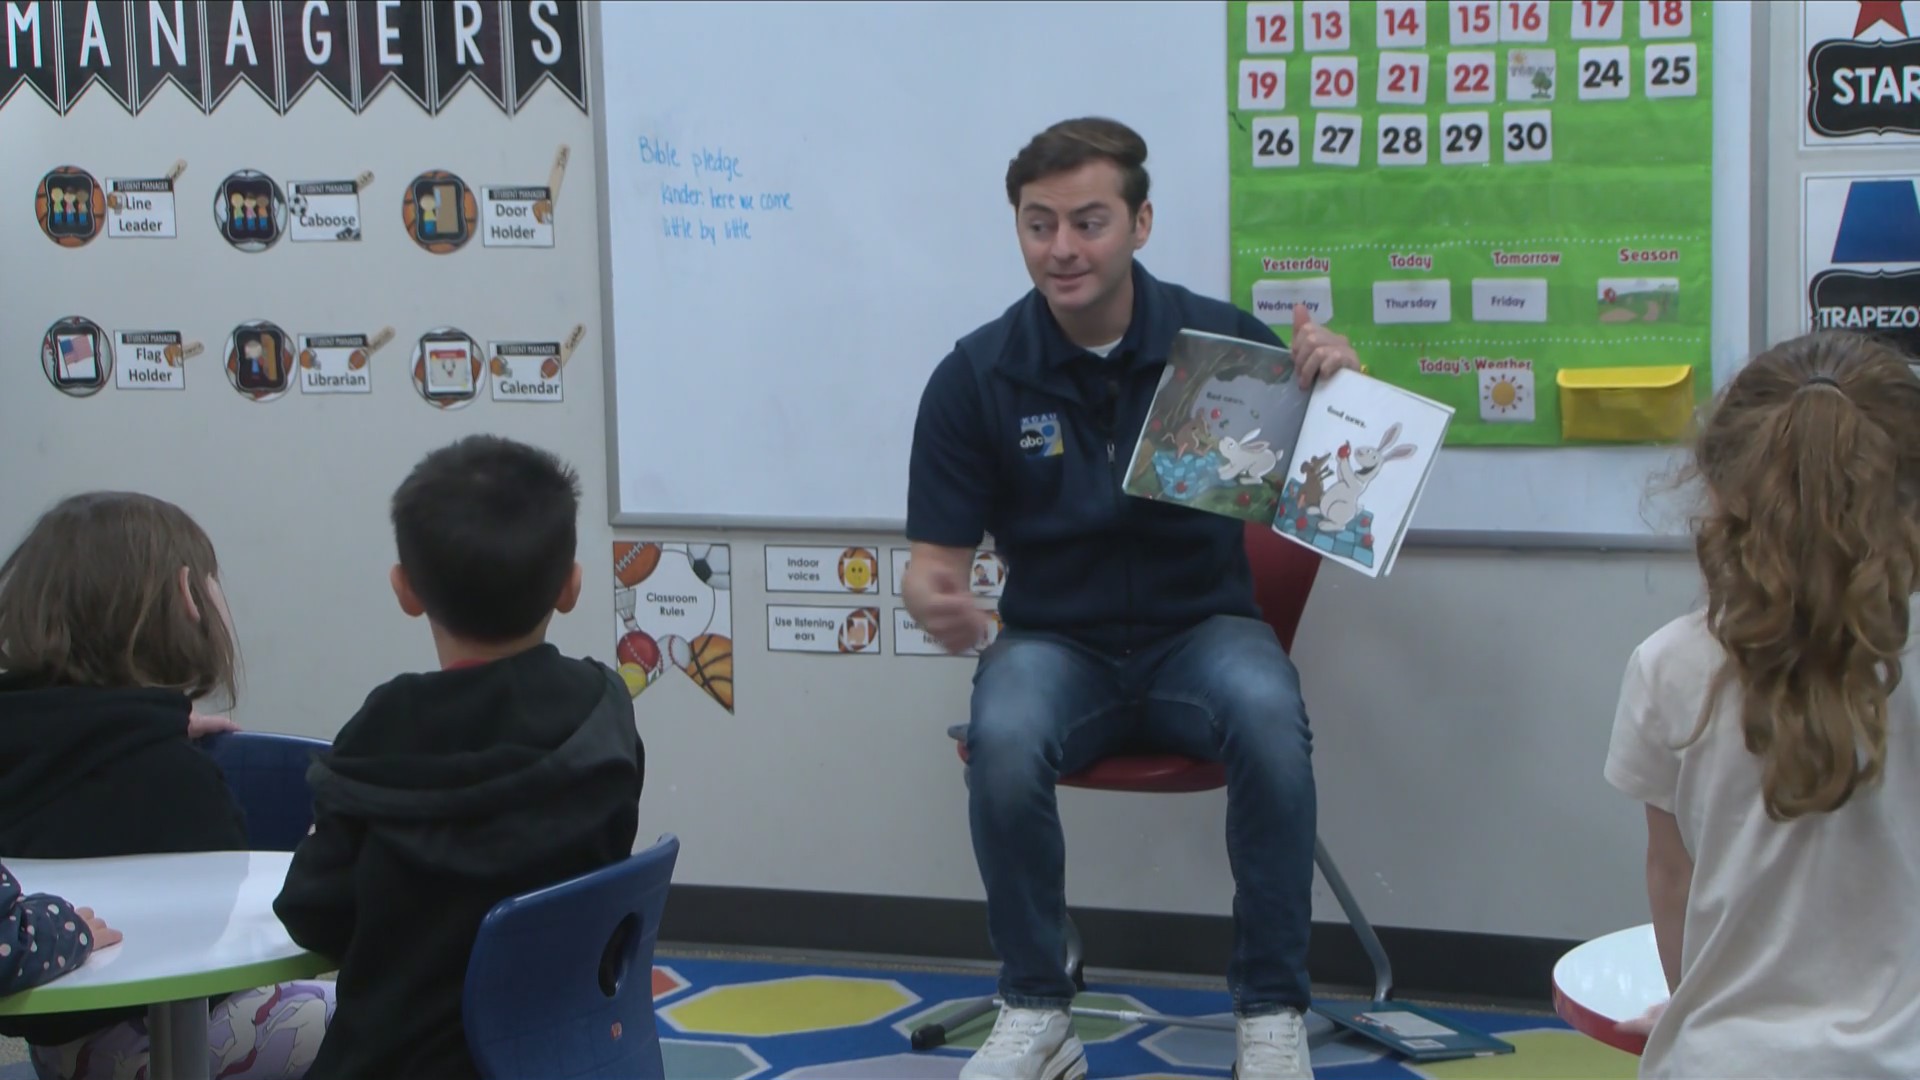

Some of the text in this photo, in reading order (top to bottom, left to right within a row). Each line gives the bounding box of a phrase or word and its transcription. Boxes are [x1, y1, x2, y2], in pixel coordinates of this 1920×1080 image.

[1255, 0, 1684, 43] 12 13 14 15 16 17 18
[6, 0, 564, 68] MANAGERS
[1248, 71, 1278, 99] 19
[1315, 68, 1354, 97] 20
[1387, 64, 1420, 93] 21
[1453, 64, 1490, 92] 22
[1583, 59, 1623, 88] 24
[1651, 57, 1690, 85] 25
[1832, 65, 1920, 105] STAR
[1257, 121, 1547, 156] 26 27 28 29 30
[639, 134, 743, 182] Bible pledge
[125, 196, 152, 211] Line
[759, 192, 793, 210] come
[495, 203, 529, 217] Door
[119, 218, 163, 232] Leader
[299, 213, 356, 227] Caboose
[490, 226, 536, 240] Holder
[699, 219, 716, 246] by
[1390, 254, 1433, 269] Today
[1493, 251, 1561, 265] Tomorrow
[1619, 248, 1680, 262] Season
[1263, 257, 1330, 273] Yesterday
[1256, 300, 1320, 313] Wedneay
[1385, 298, 1438, 309] Thursday
[1490, 296, 1526, 309] Friday
[1820, 305, 1920, 329] TRAPEZO
[136, 348, 162, 364] Flag
[1419, 356, 1531, 374] Today's Weather
[128, 369, 172, 382] Holder
[307, 373, 366, 387] Librarian
[500, 380, 560, 395] Calendar
[1326, 404, 1367, 429] Good news.
[1020, 435, 1044, 449] abc
[787, 558, 819, 568] Indoor
[788, 571, 820, 582] voices
[646, 592, 698, 604] Classroom
[660, 606, 685, 617] Rules
[775, 616, 835, 630] Use listening
[795, 632, 815, 642] ears
